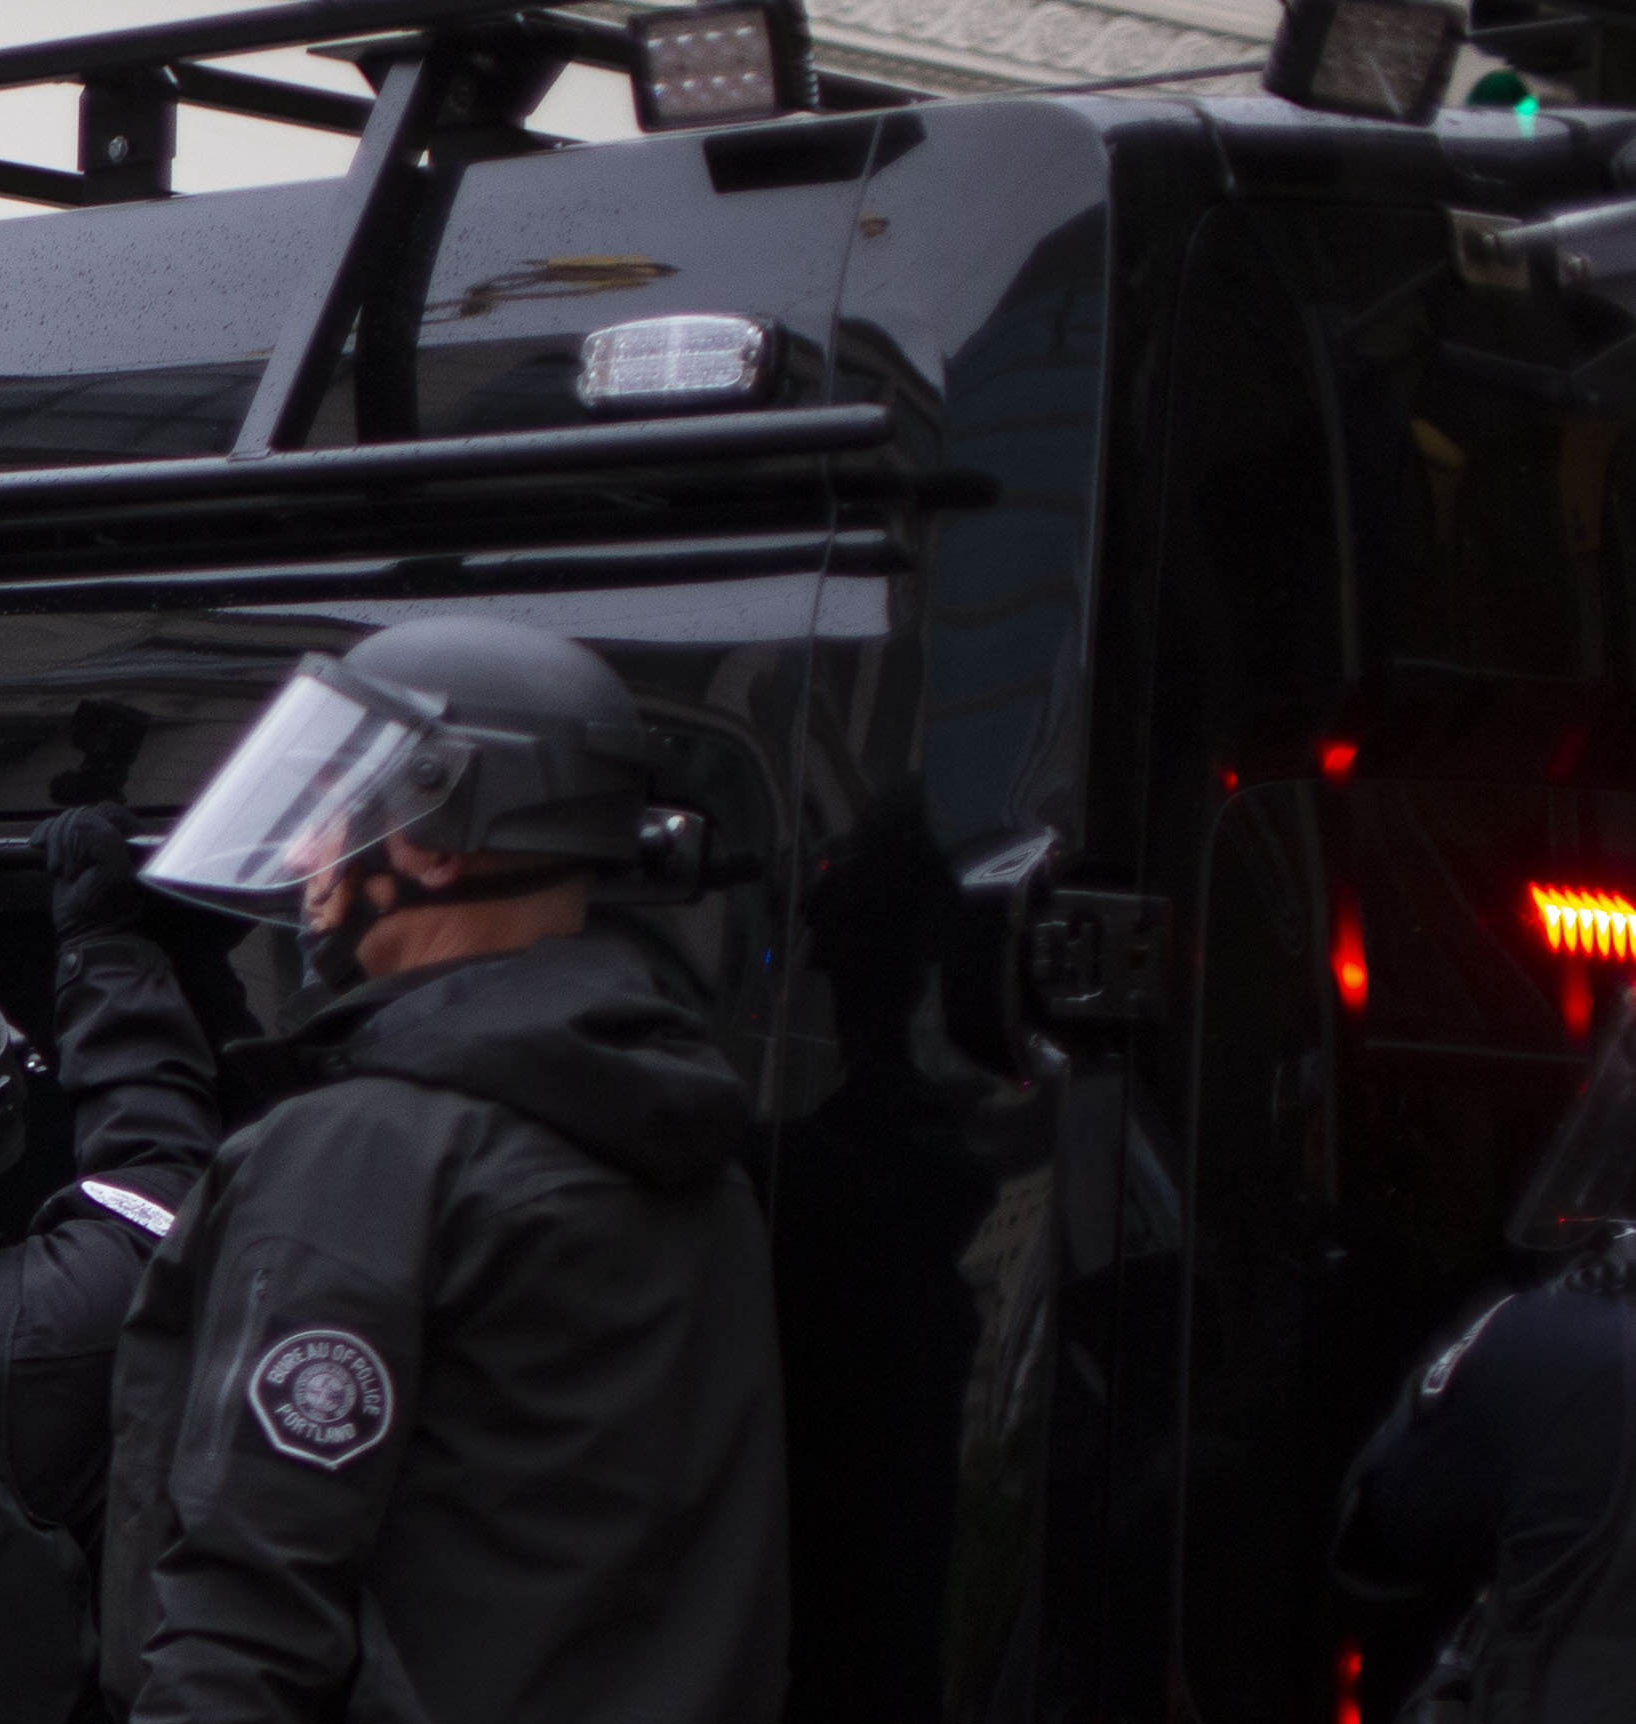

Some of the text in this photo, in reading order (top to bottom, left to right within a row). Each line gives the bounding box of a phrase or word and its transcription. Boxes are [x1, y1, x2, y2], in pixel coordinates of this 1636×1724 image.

[266, 1342, 330, 1384] BUREAU
[332, 1344, 358, 1363] OF
[350, 1356, 381, 1416] POLICE
[274, 1402, 357, 1444] PORTLAND
